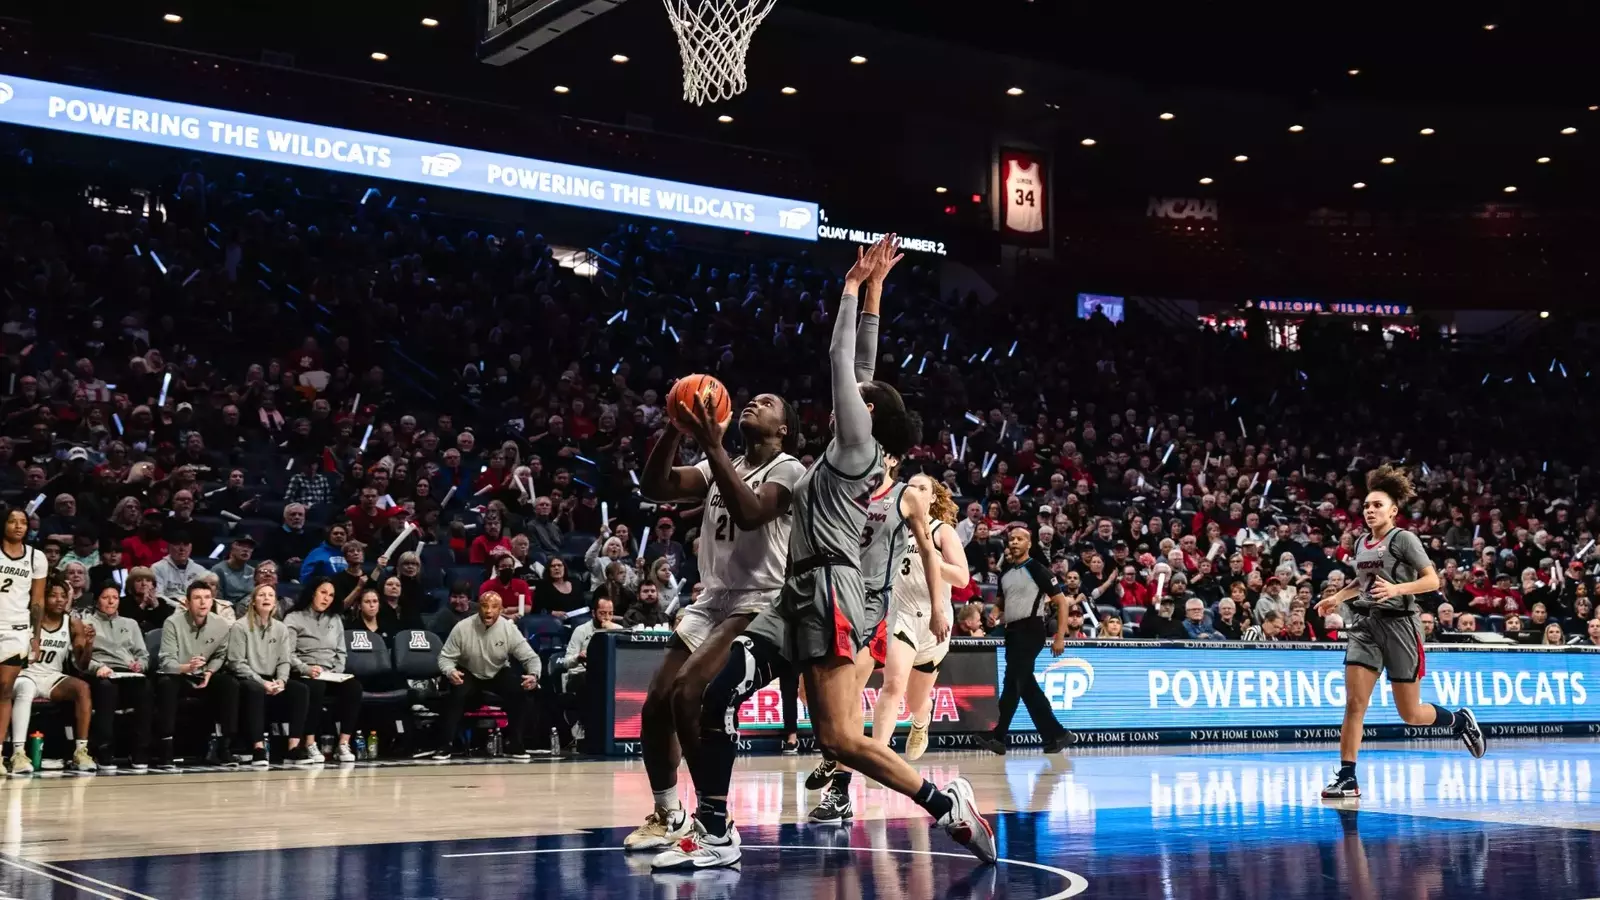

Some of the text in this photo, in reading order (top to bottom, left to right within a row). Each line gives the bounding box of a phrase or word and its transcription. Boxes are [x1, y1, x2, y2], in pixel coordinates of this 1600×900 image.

[48, 96, 392, 168] POWERING THE WILDCATS
[487, 164, 756, 222] POWERING THE WILDCATS
[1015, 188, 1035, 207] 34
[1147, 198, 1218, 220] NCAA
[818, 225, 848, 240] QUAY
[1259, 300, 1400, 314] ARIZONA WILDCATS
[715, 514, 735, 542] 21
[901, 558, 911, 576] 3
[1148, 669, 1346, 709] POWERING
[1432, 671, 1588, 707] WILDCATS
[1097, 733, 1125, 742] HOME
[1129, 731, 1159, 741] LOANS
[1221, 730, 1248, 739] HOME
[1252, 729, 1279, 739] LOANS
[1431, 726, 1454, 736] HOME
[1517, 725, 1538, 734] HOME
[1541, 724, 1564, 733] LOANS
[1011, 734, 1043, 744] LOANS
